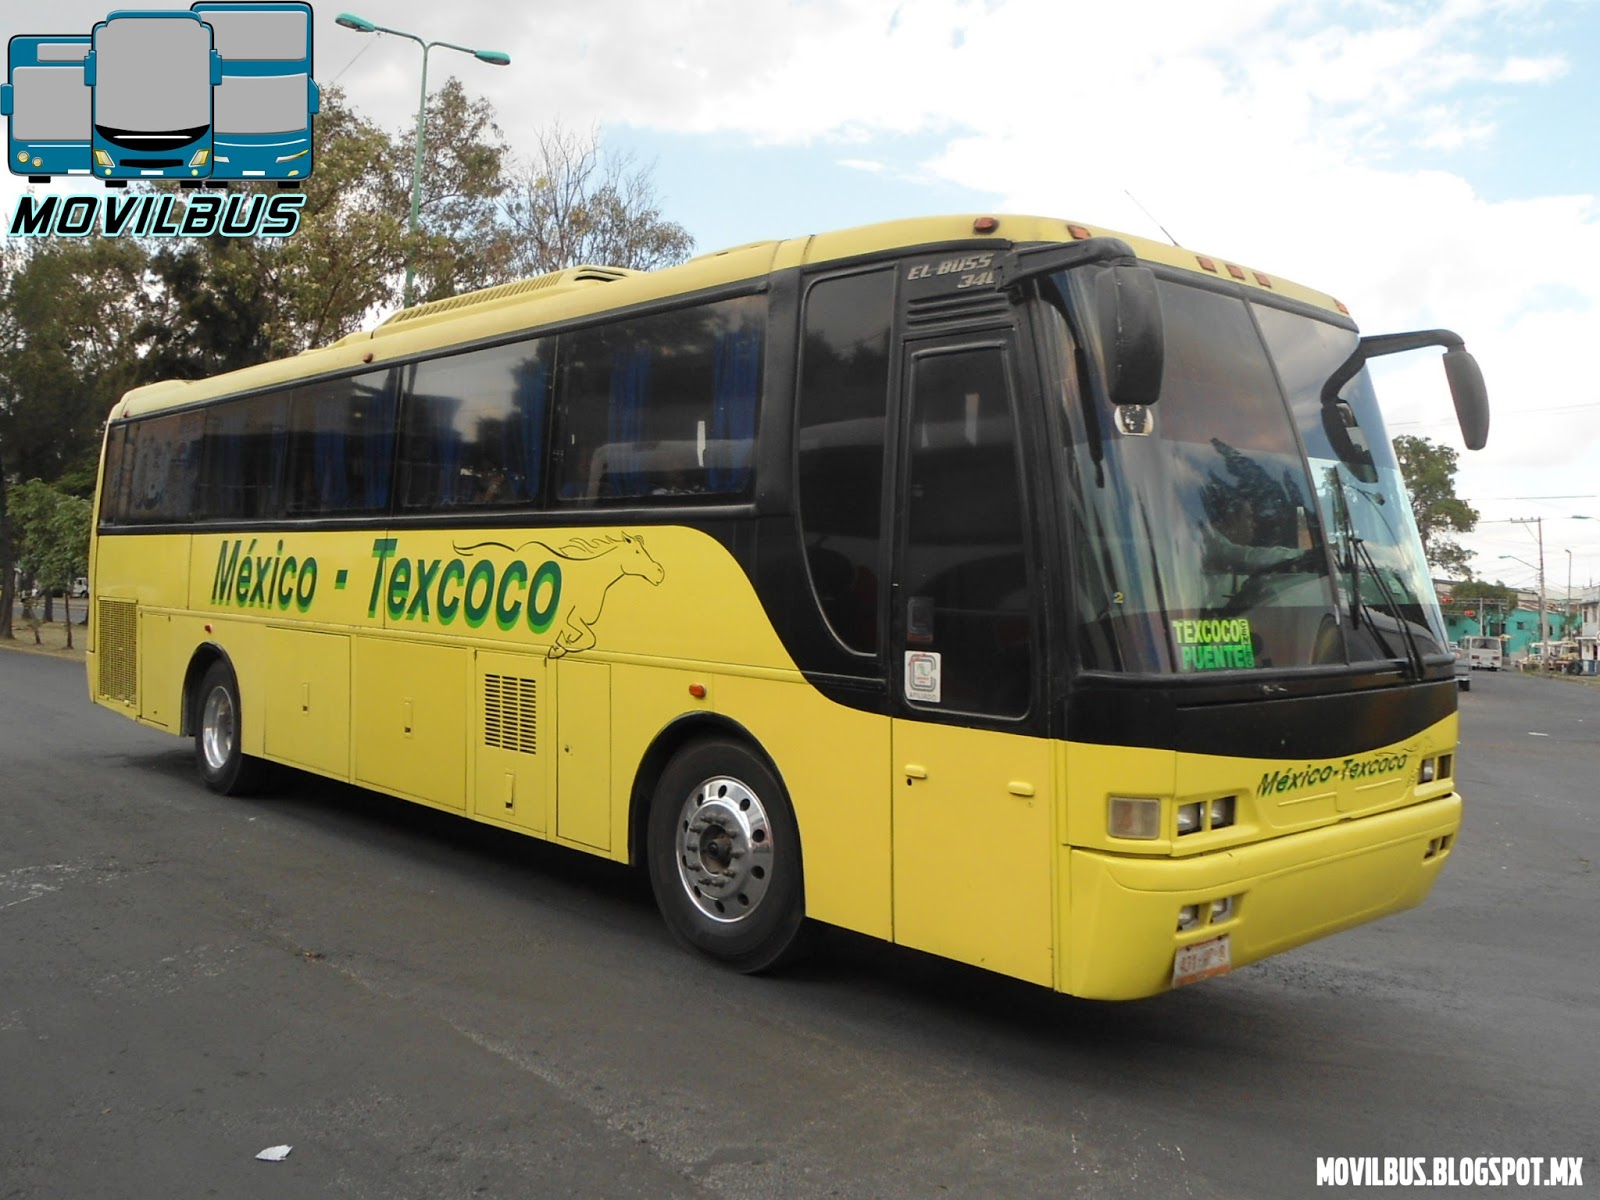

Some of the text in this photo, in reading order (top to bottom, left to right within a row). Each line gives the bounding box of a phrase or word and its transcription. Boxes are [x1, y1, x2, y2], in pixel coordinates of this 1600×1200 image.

[907, 253, 995, 280] EL BUSS
[210, 537, 318, 613] México
[367, 537, 562, 635] Texcoco
[1113, 591, 1125, 604] 2
[1171, 619, 1240, 644] TEXCOCO
[1181, 645, 1245, 670] PUENTE
